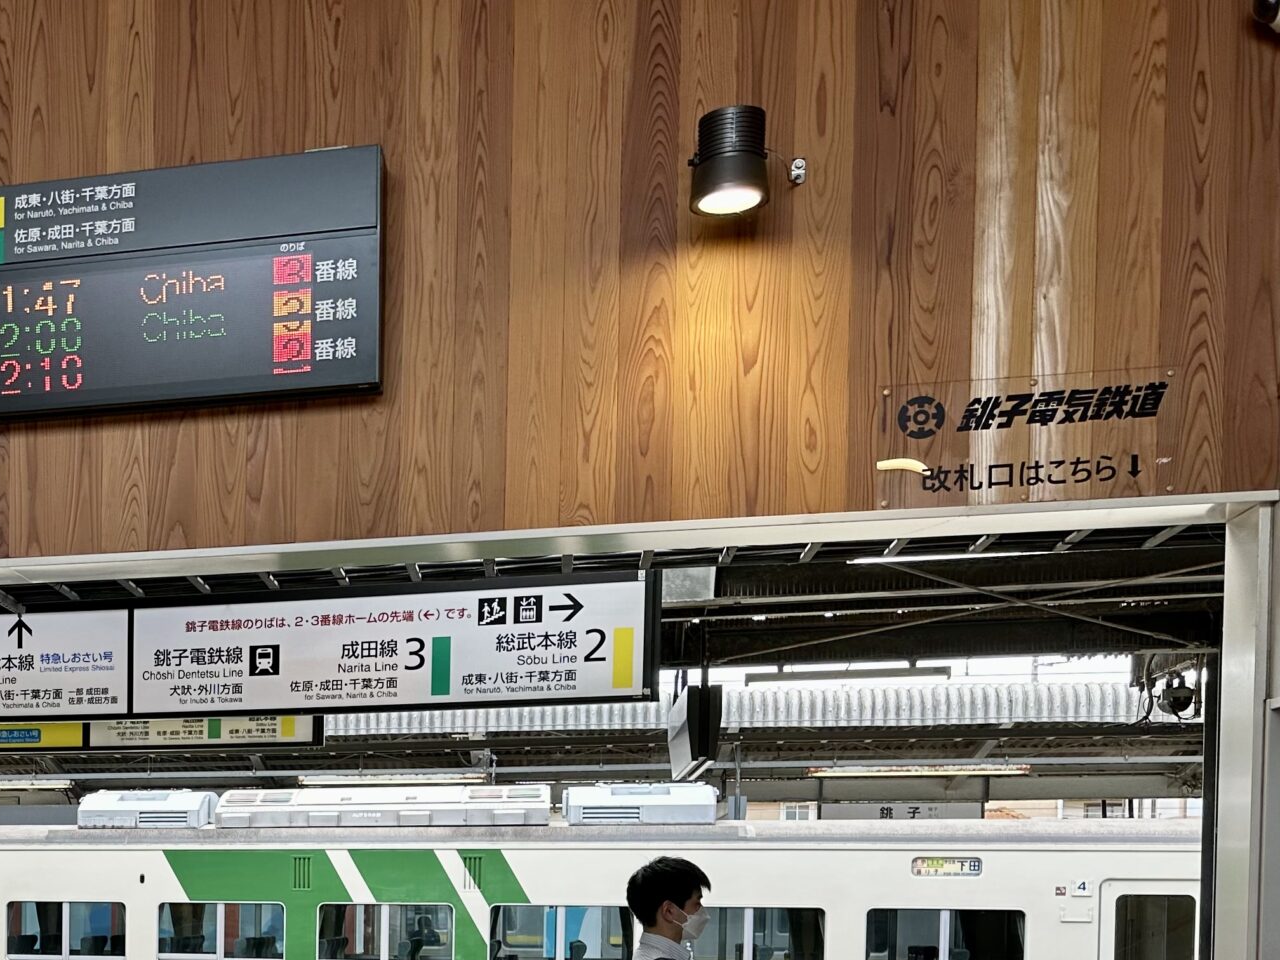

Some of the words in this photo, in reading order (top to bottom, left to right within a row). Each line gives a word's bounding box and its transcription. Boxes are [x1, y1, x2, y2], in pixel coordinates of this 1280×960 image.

[14, 183, 136, 209] 成東・八街・千葉方面
[14, 211, 25, 220] for
[57, 204, 99, 216] Yachimata
[101, 202, 108, 211] &
[109, 200, 134, 210] Chiba
[14, 218, 135, 244] 佐原・成田・千葉方面
[14, 245, 25, 254] for
[27, 242, 58, 254] Sawara,
[61, 240, 85, 250] Narita
[87, 238, 94, 247] &
[95, 236, 119, 247] Chiba
[280, 242, 306, 252] のりば
[315, 258, 357, 283] 番線
[314, 297, 357, 322] 番線
[314, 337, 357, 361] 番線
[956, 381, 1168, 432] 銚子電気鉄道
[922, 456, 1117, 492] 改札口はこちら
[341, 639, 398, 659] 成田線
[495, 630, 578, 653] 総武本線
[583, 628, 607, 662] 2
[40, 652, 114, 665] 特急しおさい号
[154, 646, 243, 667] 銚子電鉄線
[404, 637, 426, 671] 3
[552, 653, 577, 664] Line
[178, 669, 220, 680] Dentetsu
[223, 668, 243, 678] Line
[337, 663, 370, 674] Narita
[375, 662, 398, 672] Line
[290, 677, 398, 692] 佐原・成田・千葉方面
[461, 670, 577, 686] 成東・八街・千葉方面
[305, 693, 314, 701] for
[376, 690, 398, 698] Chiba
[464, 687, 474, 695] for
[505, 684, 544, 694] Yachimata
[546, 683, 552, 692] &
[554, 682, 577, 692] Chiba
[42, 701, 61, 709] Chiba
[179, 697, 188, 705] for
[1077, 881, 1086, 892] 4
